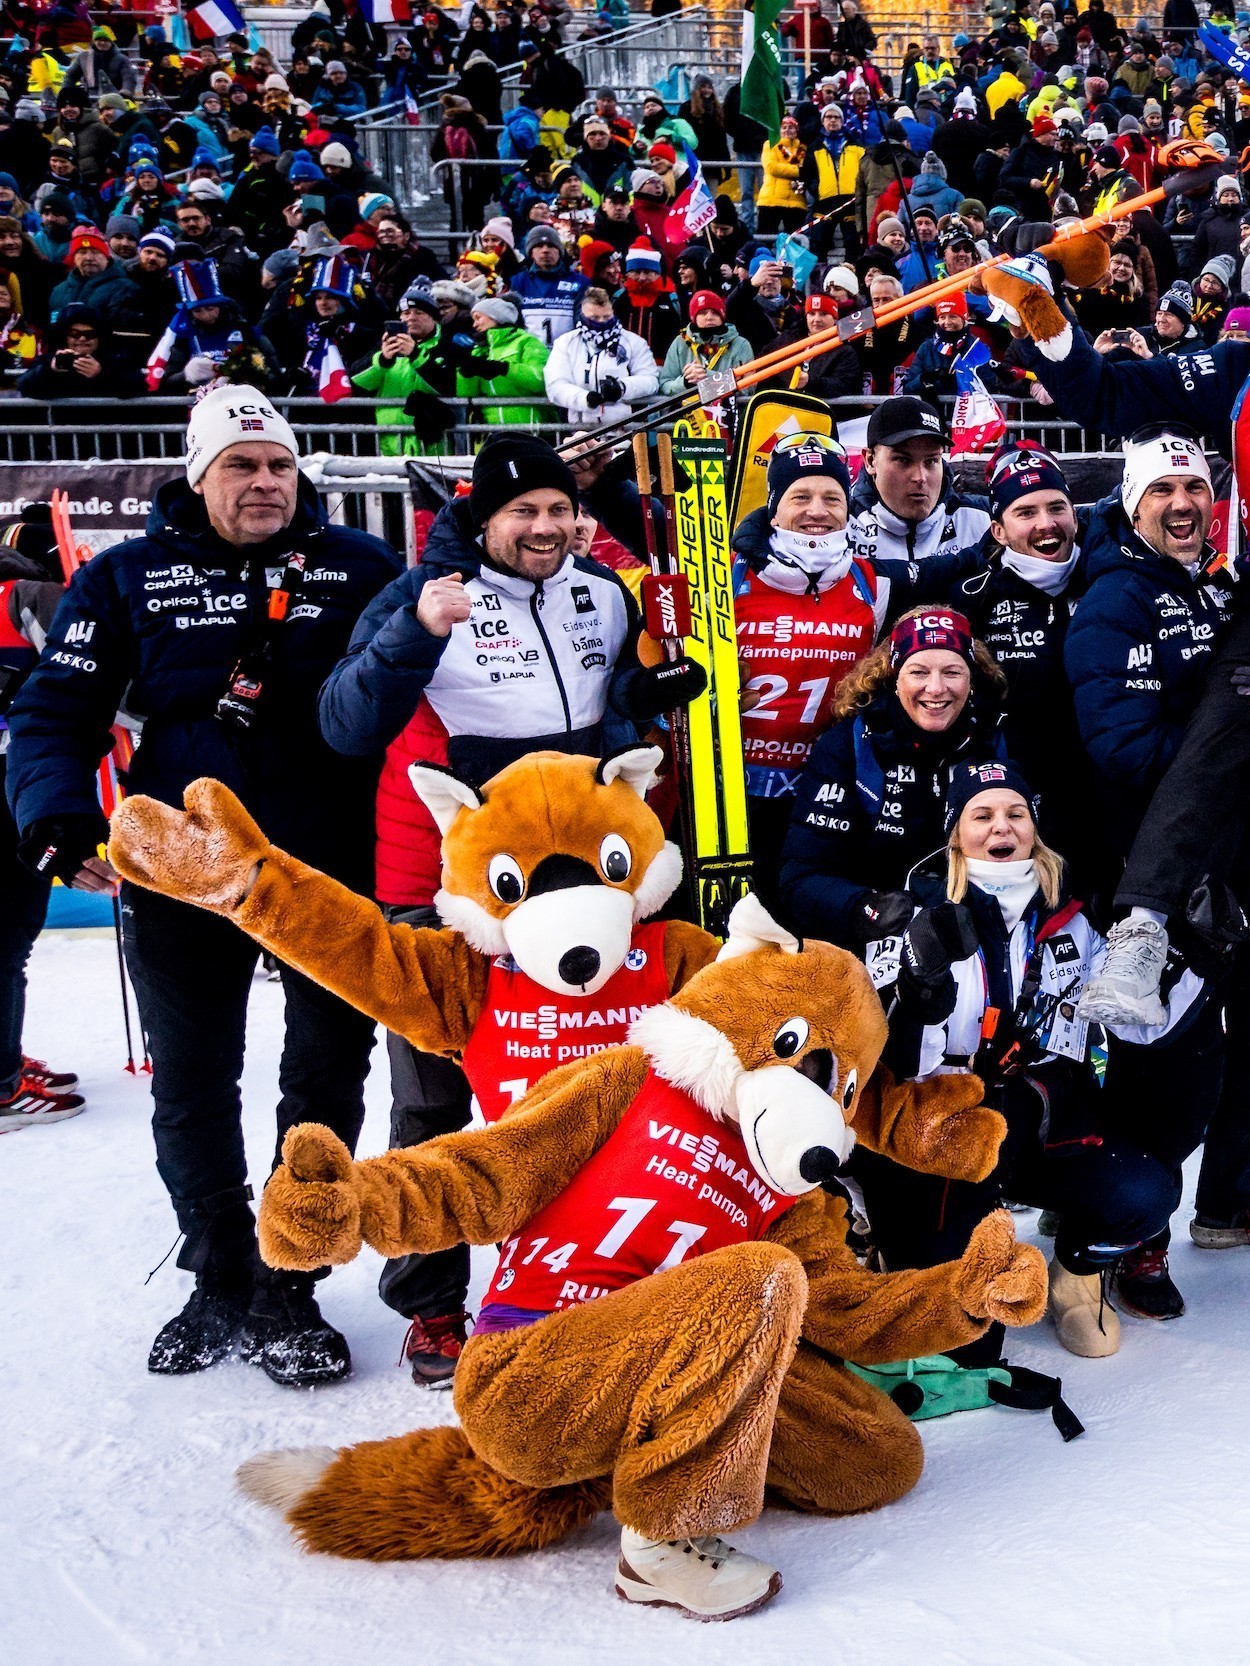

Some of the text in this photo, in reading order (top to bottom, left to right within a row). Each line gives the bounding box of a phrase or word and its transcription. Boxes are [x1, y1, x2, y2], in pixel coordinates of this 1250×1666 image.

[226, 403, 274, 419] ice
[1160, 440, 1197, 456] ice
[1008, 456, 1043, 475] ice
[679, 495, 705, 644] FISCHER
[706, 495, 732, 644] FISCHER
[143, 577, 194, 590] CRAFT
[203, 592, 248, 613] ice
[190, 616, 237, 626] LAPUA
[471, 619, 509, 638] ice
[914, 616, 954, 632] ice
[1013, 629, 1046, 648] ice
[50, 650, 98, 672] ASKO
[1005, 651, 1037, 659] LAPUA
[502, 671, 536, 680] LAPUA
[741, 674, 830, 724] 21
[806, 812, 851, 832] ASKO
[700, 860, 754, 871] FISCHER
[494, 1005, 652, 1040] VIESSMANN
[506, 1040, 552, 1059] Heat
[648, 1119, 777, 1213] VIESSMANN
[645, 1155, 750, 1228] Heat pumps
[500, 1235, 580, 1275] 114
